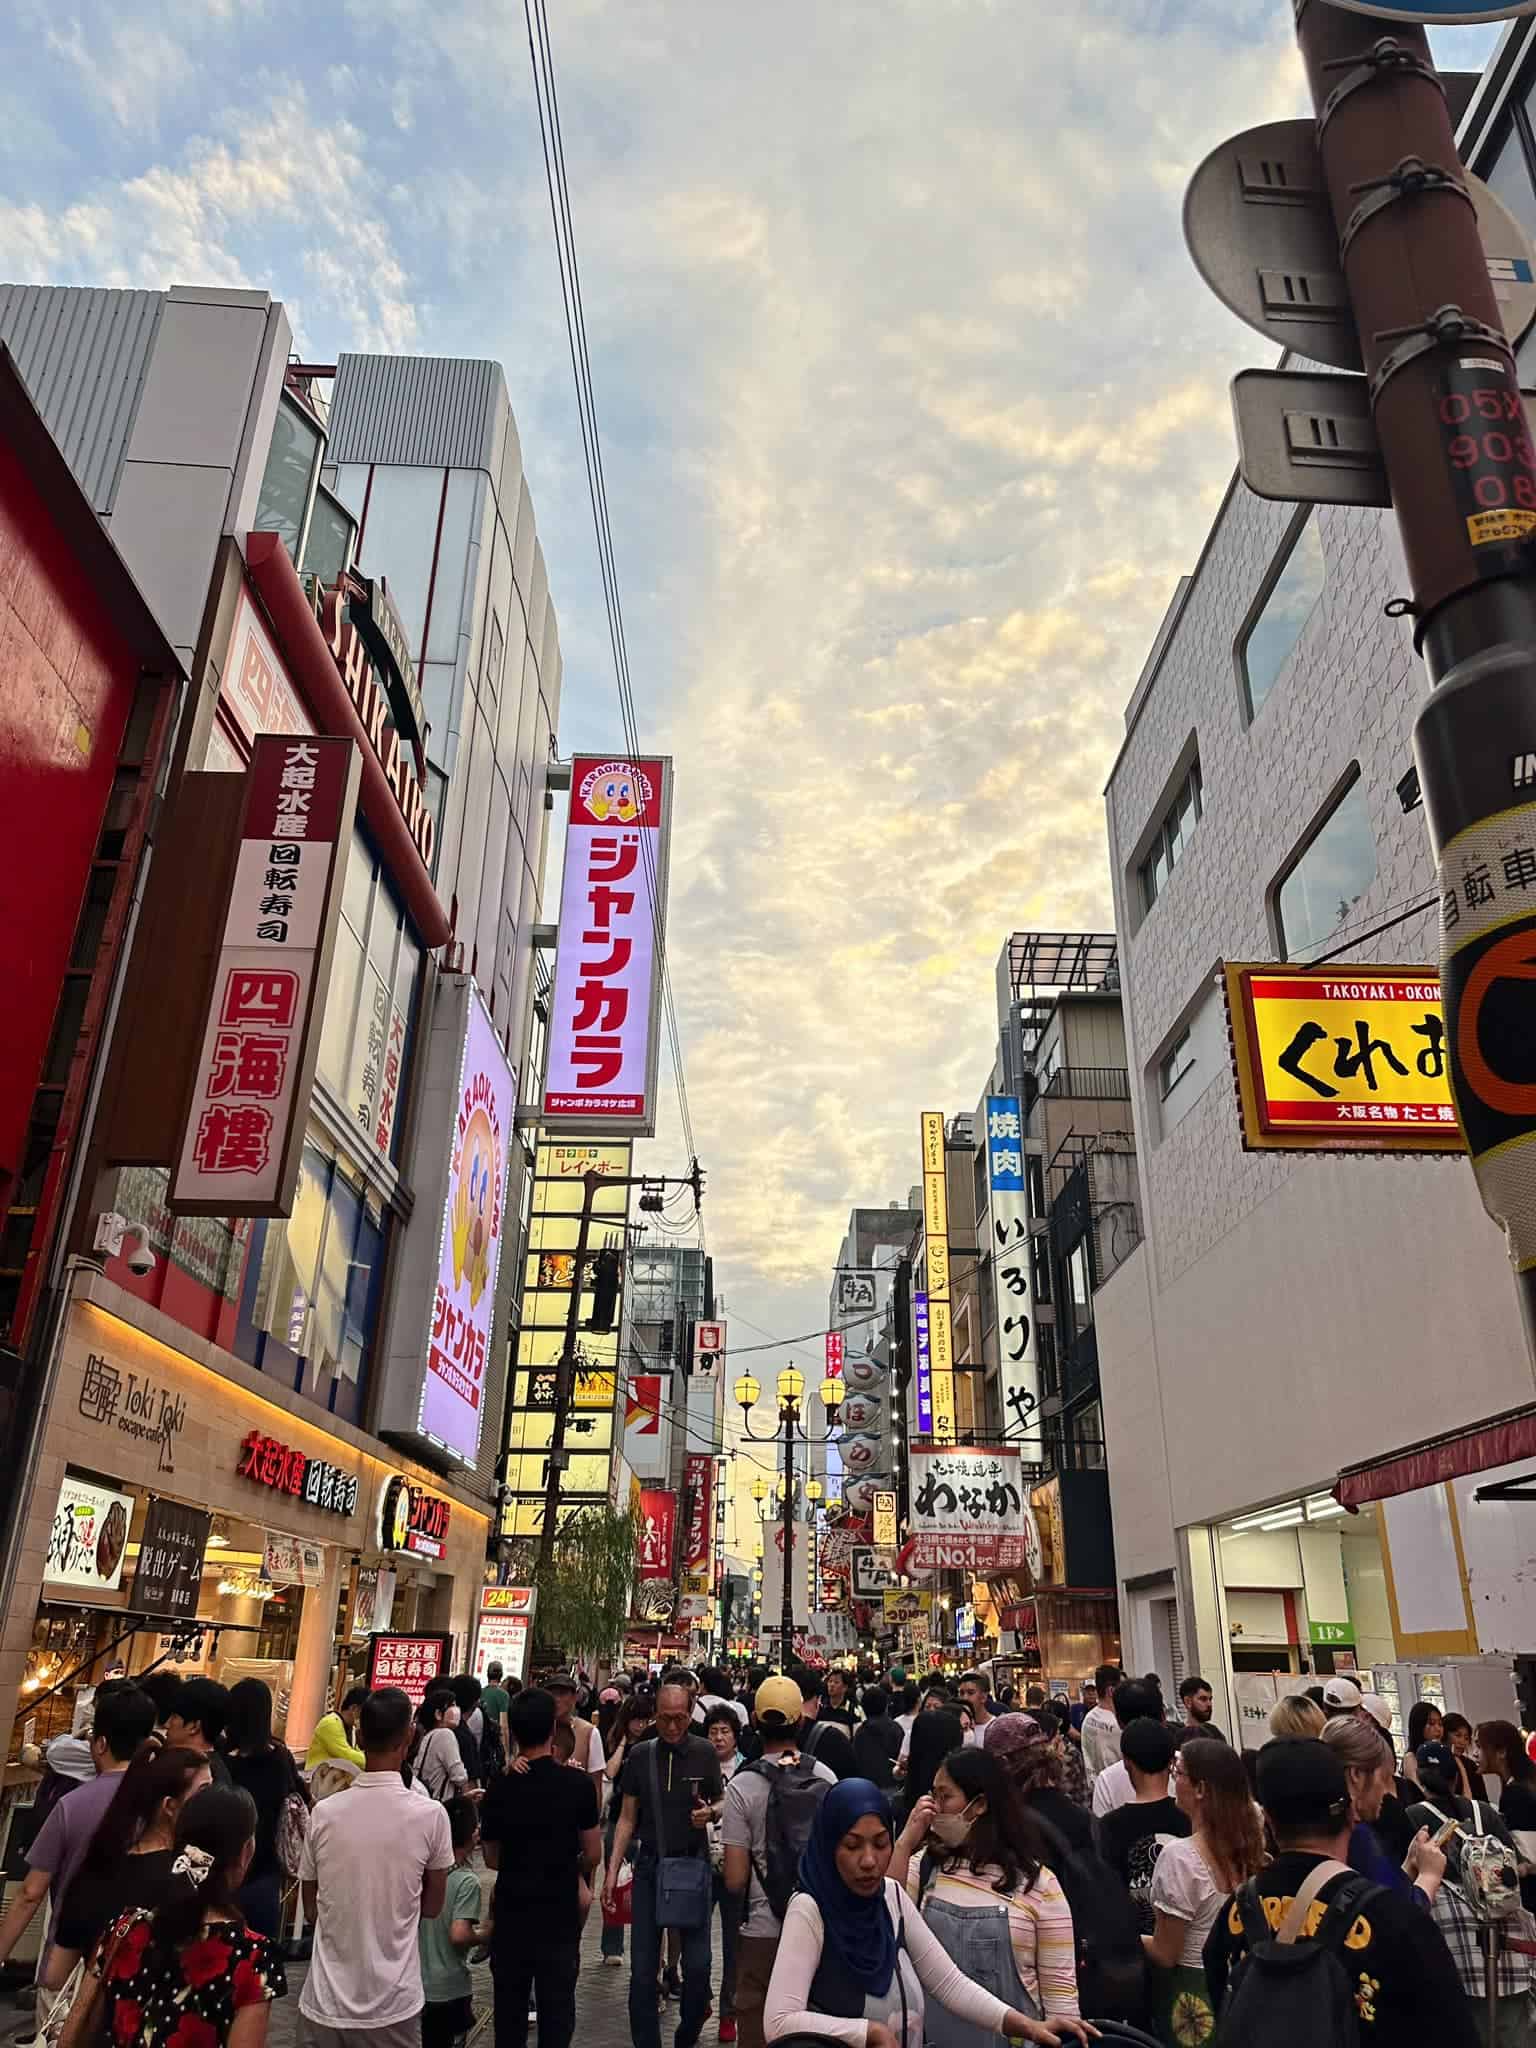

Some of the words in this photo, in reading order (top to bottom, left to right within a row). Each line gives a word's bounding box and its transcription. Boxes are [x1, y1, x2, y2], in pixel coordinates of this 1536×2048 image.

[272, 743, 320, 839] 大起水産
[582, 764, 629, 798] KARAOKE
[256, 843, 301, 944] 回転寿司
[570, 834, 640, 1089] ジャンカラ
[1322, 984, 1395, 999] TAKOYAKI
[193, 968, 300, 1176] 四海樓
[560, 1160, 623, 1174] レインボー
[989, 1112, 1021, 1178] 焼肉
[432, 1282, 486, 1381] ジャンカラ
[995, 1218, 1036, 1428] いろりや
[125, 1373, 157, 1420] Toki
[159, 1388, 187, 1434] Toki
[241, 1432, 306, 1497] 大起水産
[304, 1459, 360, 1518] 回転寿司
[914, 1472, 1022, 1520] わなか
[139, 1545, 201, 1583] 脱出ゲーム
[375, 1659, 437, 1678] 回転寿司
[380, 1642, 437, 1659] 大起水産
